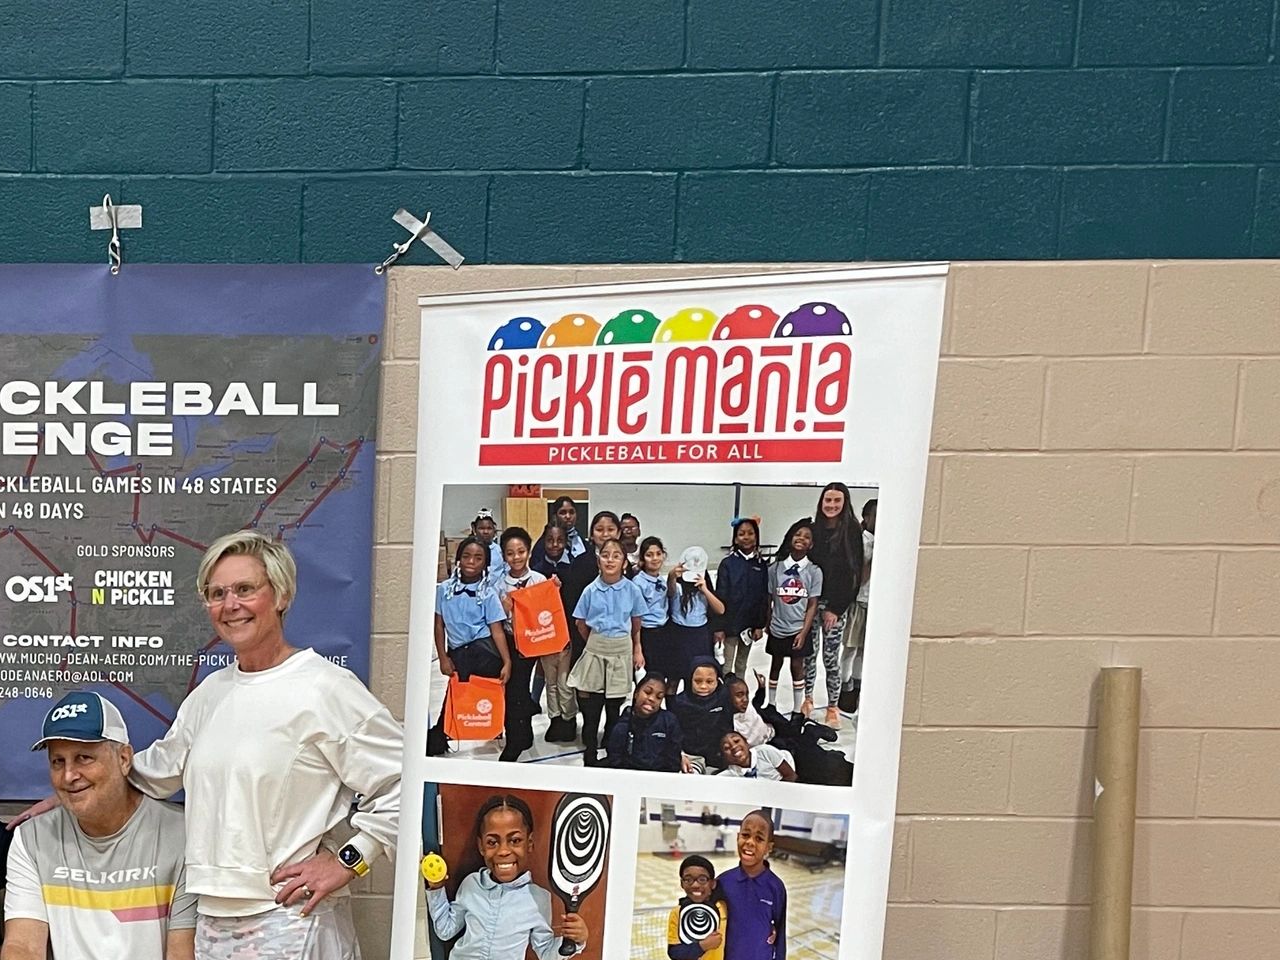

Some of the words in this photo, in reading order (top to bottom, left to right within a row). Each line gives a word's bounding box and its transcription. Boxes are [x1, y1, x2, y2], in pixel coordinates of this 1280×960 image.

[548, 444, 667, 462] PICKLEBALL
[677, 444, 718, 461] FOR
[727, 443, 763, 460] ALL
[91, 477, 152, 494] GAMES
[158, 477, 176, 494] IN
[182, 477, 204, 495] 48
[209, 477, 278, 495] STATES
[11, 502, 34, 519] 48
[39, 502, 85, 520] DAYS
[76, 545, 108, 558] GOLD
[111, 545, 175, 558] SPONSORS
[94, 570, 172, 588] CHICKEN
[91, 588, 105, 605] N
[2, 634, 104, 648] CONTACT
[111, 635, 164, 648] INFO
[52, 865, 158, 885] SELKIRK
